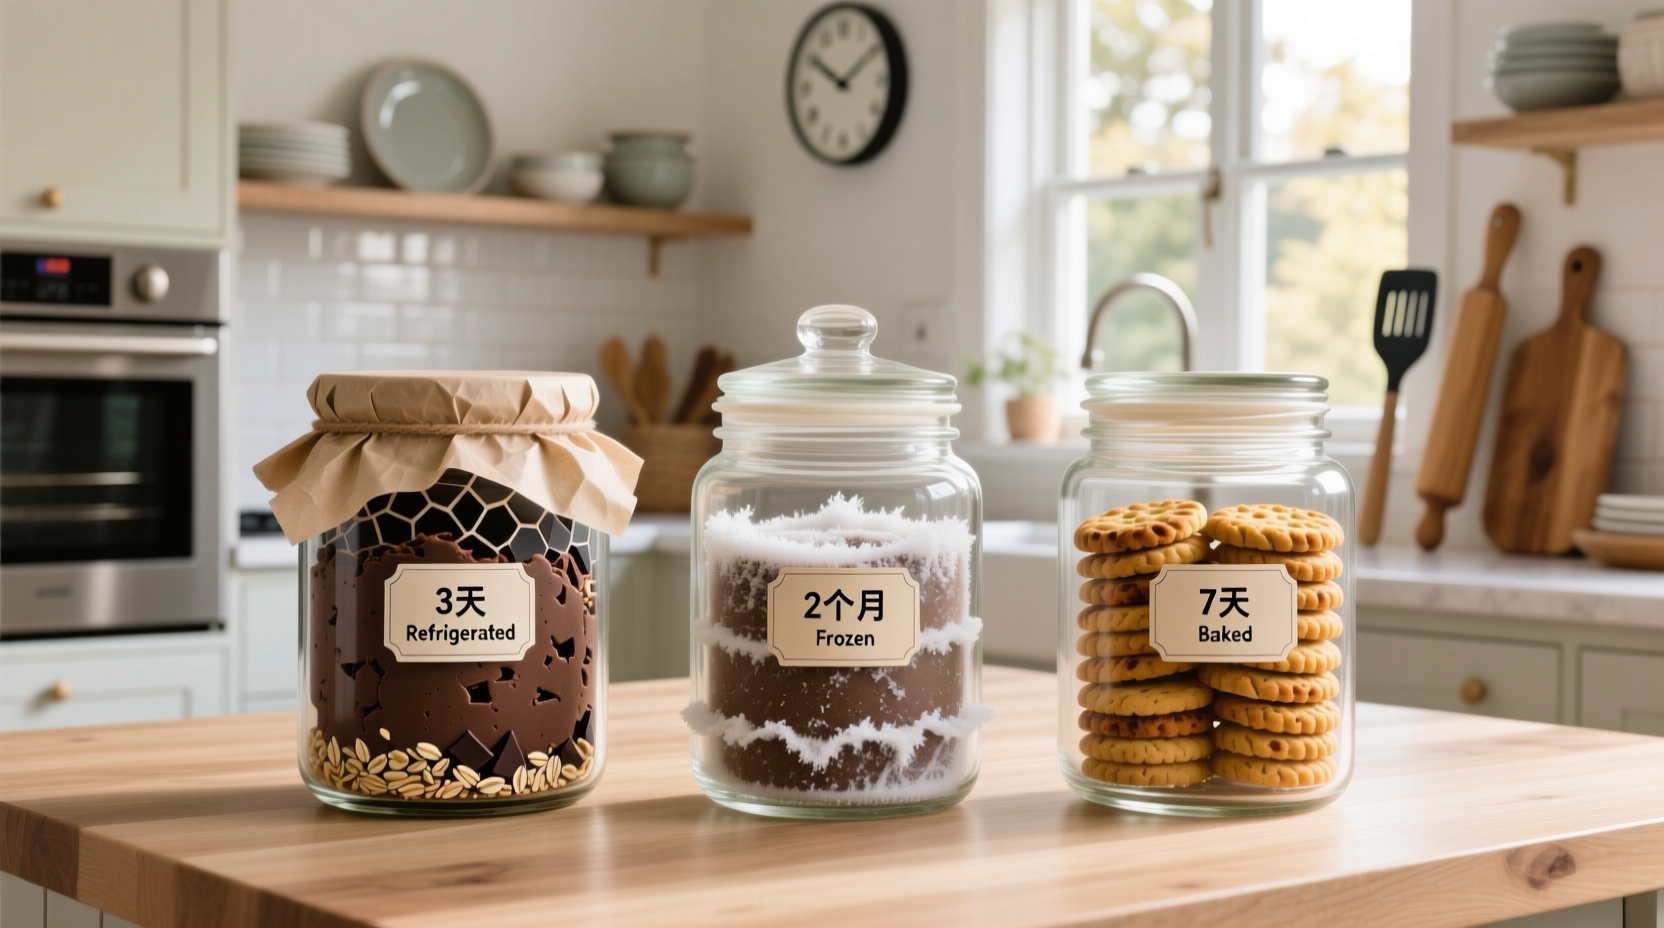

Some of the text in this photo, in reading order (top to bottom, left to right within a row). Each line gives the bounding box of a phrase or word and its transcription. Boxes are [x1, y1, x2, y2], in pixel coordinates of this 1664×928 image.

[435, 586, 486, 618] 3天
[803, 588, 884, 622] 2个月
[1199, 587, 1250, 618] 7天
[406, 623, 516, 646] Refrigerated
[816, 629, 875, 647] Frozen
[1198, 625, 1253, 643] Baked
